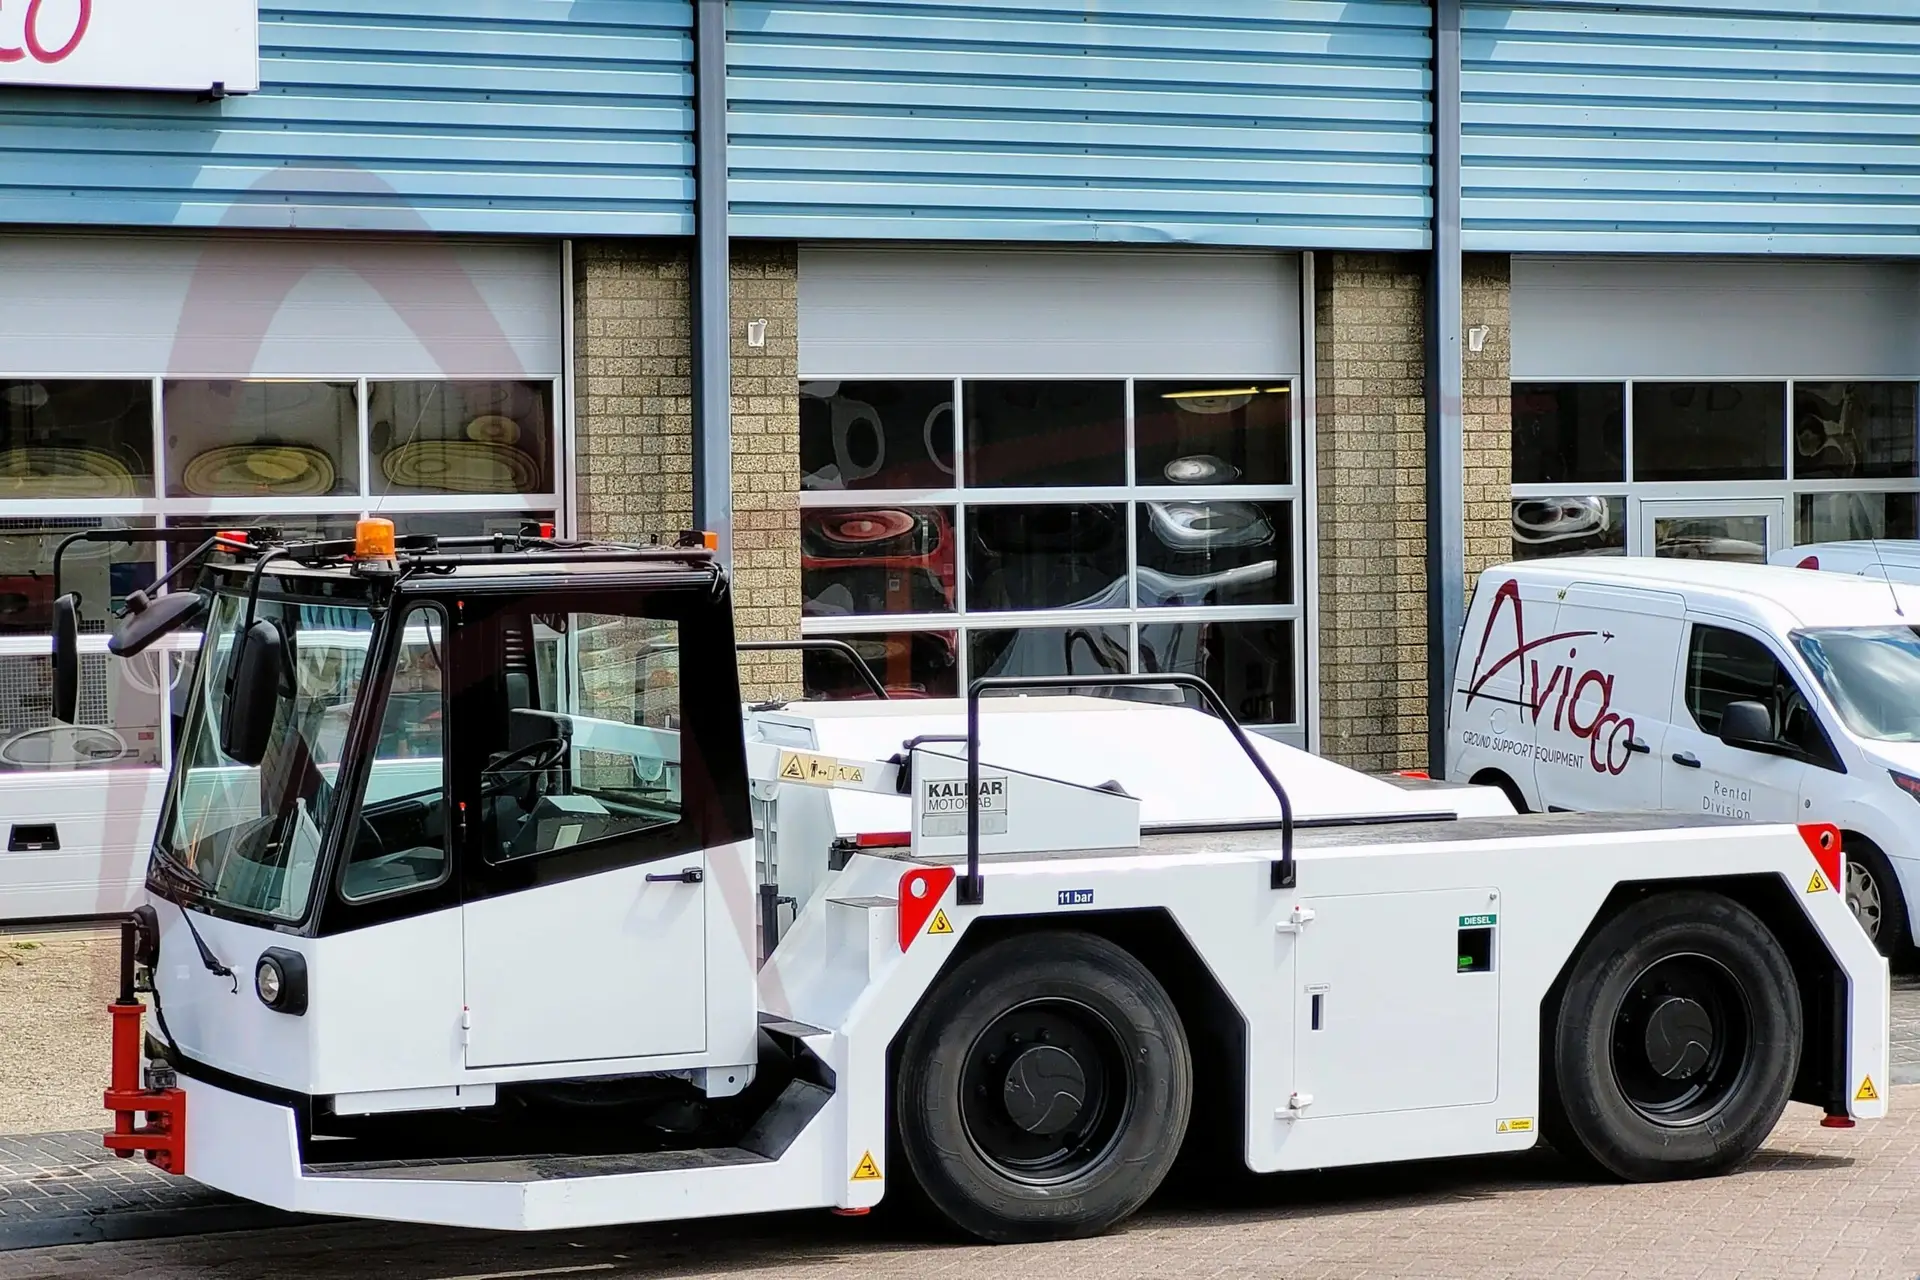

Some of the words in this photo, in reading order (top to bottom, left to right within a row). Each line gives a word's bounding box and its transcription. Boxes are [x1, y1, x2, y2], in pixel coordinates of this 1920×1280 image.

[1462, 730, 1491, 749] GROUND
[1492, 735, 1534, 758] SUPPORT
[1535, 746, 1585, 770] EQUIPMENT
[928, 781, 1003, 798] KALAR
[1713, 780, 1752, 802] Rental
[1702, 795, 1751, 820] Division
[1059, 891, 1071, 904] 11
[1074, 891, 1093, 903] bar
[1464, 916, 1492, 925] DIESEL
